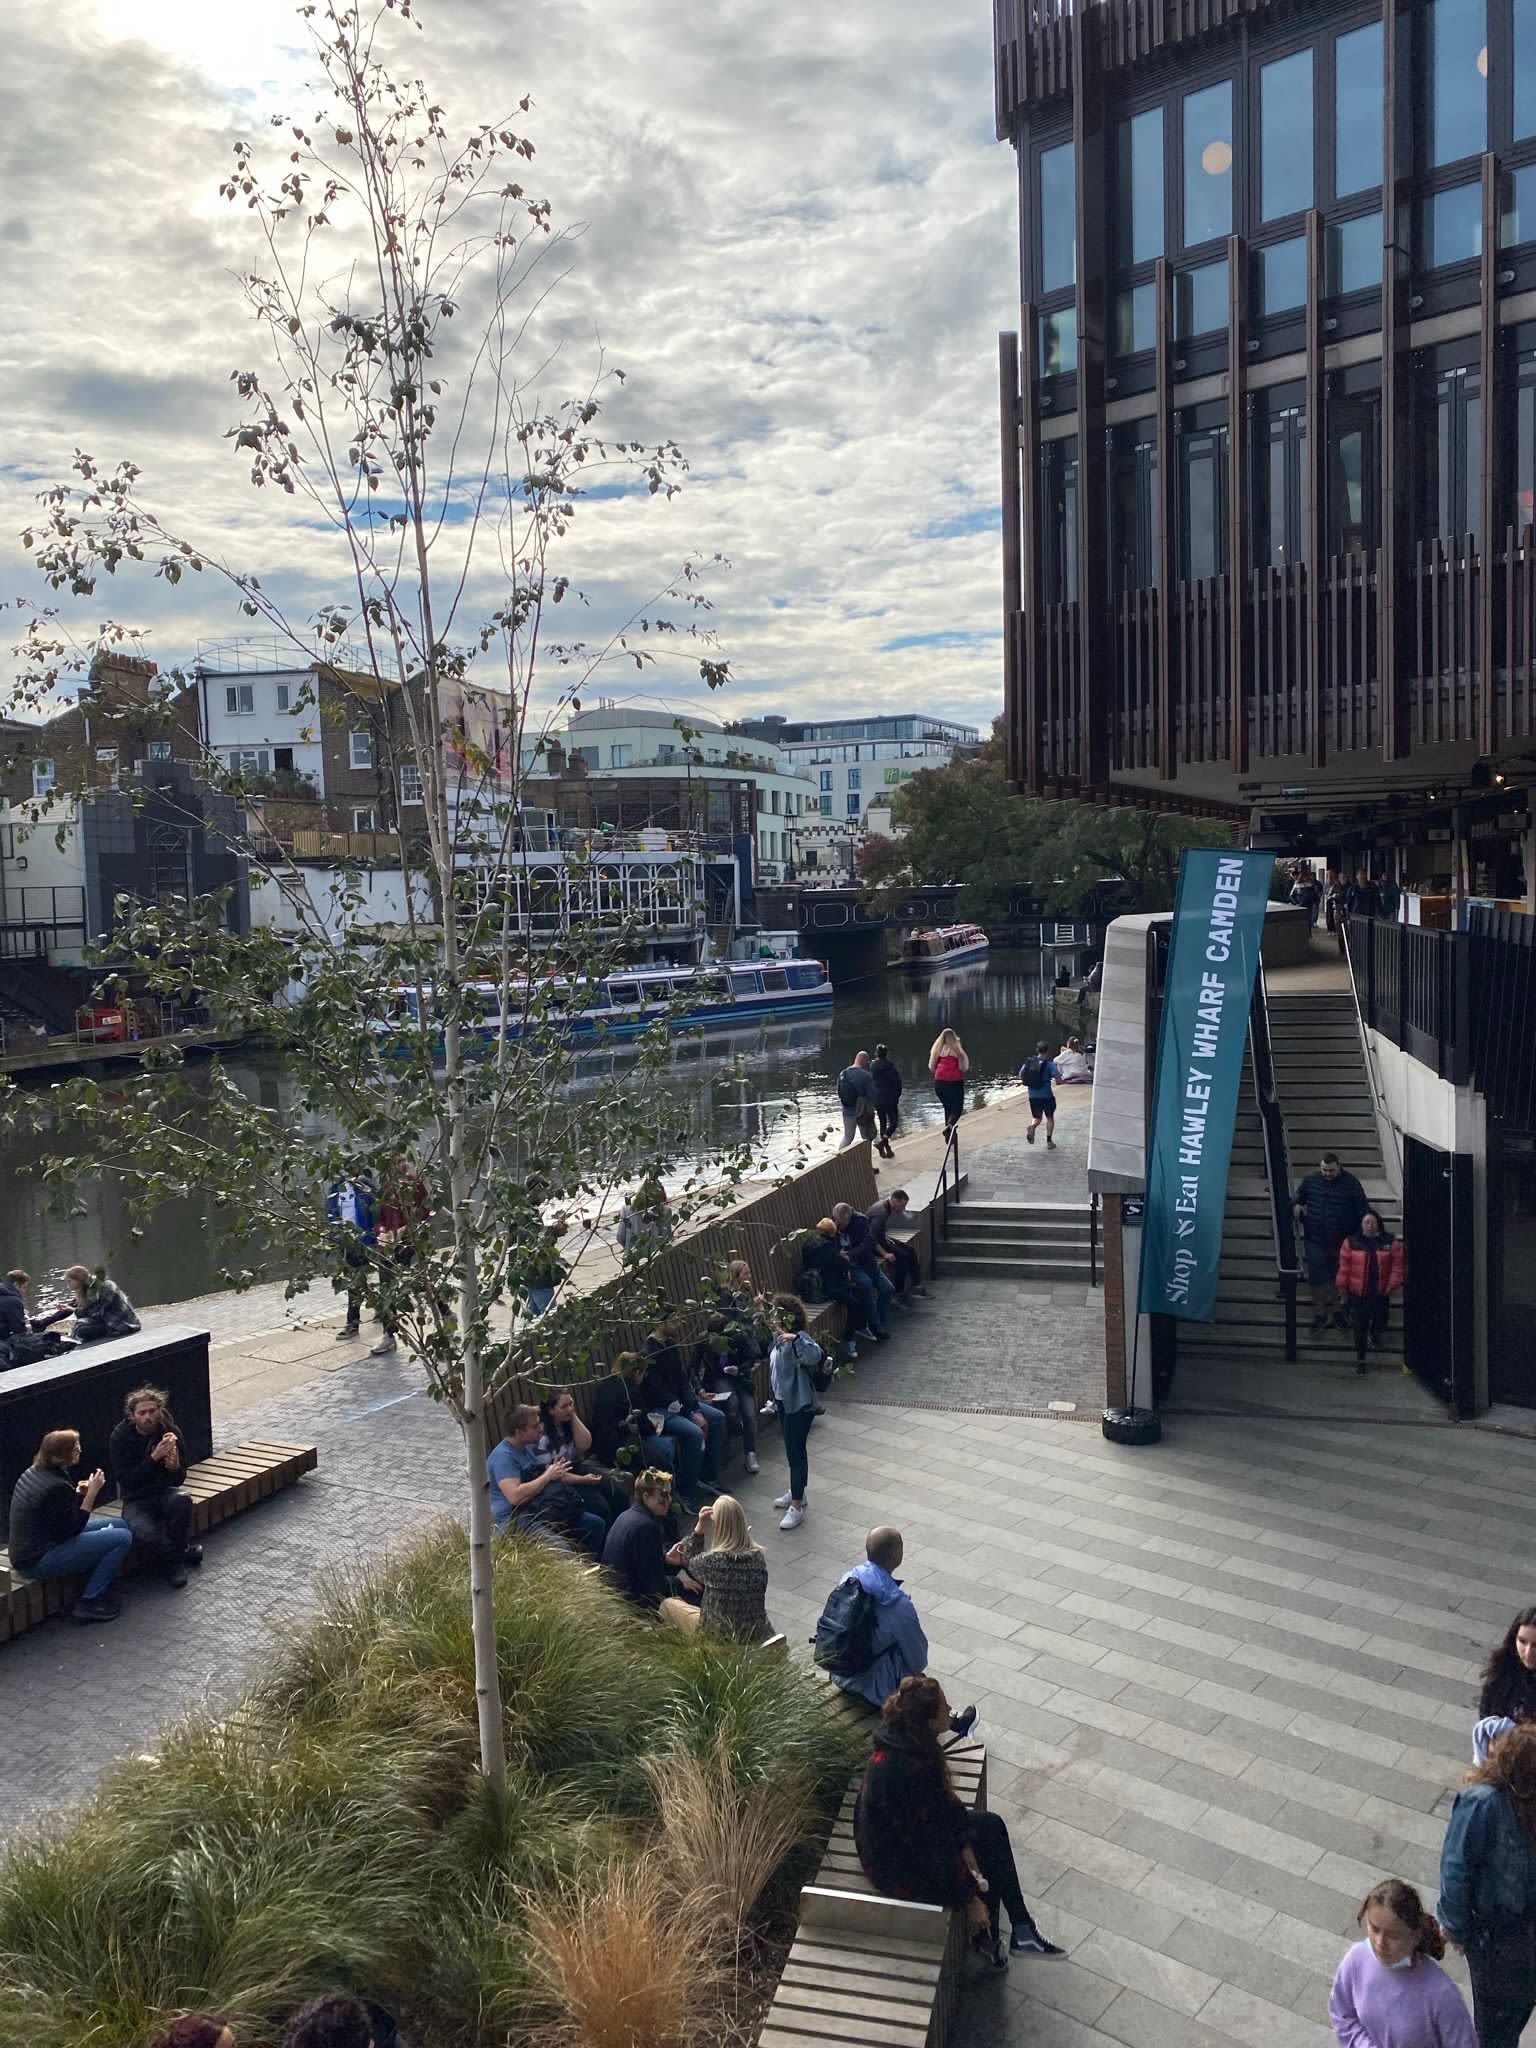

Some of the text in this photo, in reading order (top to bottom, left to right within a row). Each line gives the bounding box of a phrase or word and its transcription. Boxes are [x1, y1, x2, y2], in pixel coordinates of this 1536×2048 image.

[1166, 857, 1244, 1304] Shop & Eat HAWLEY WHARF CAMDEN
